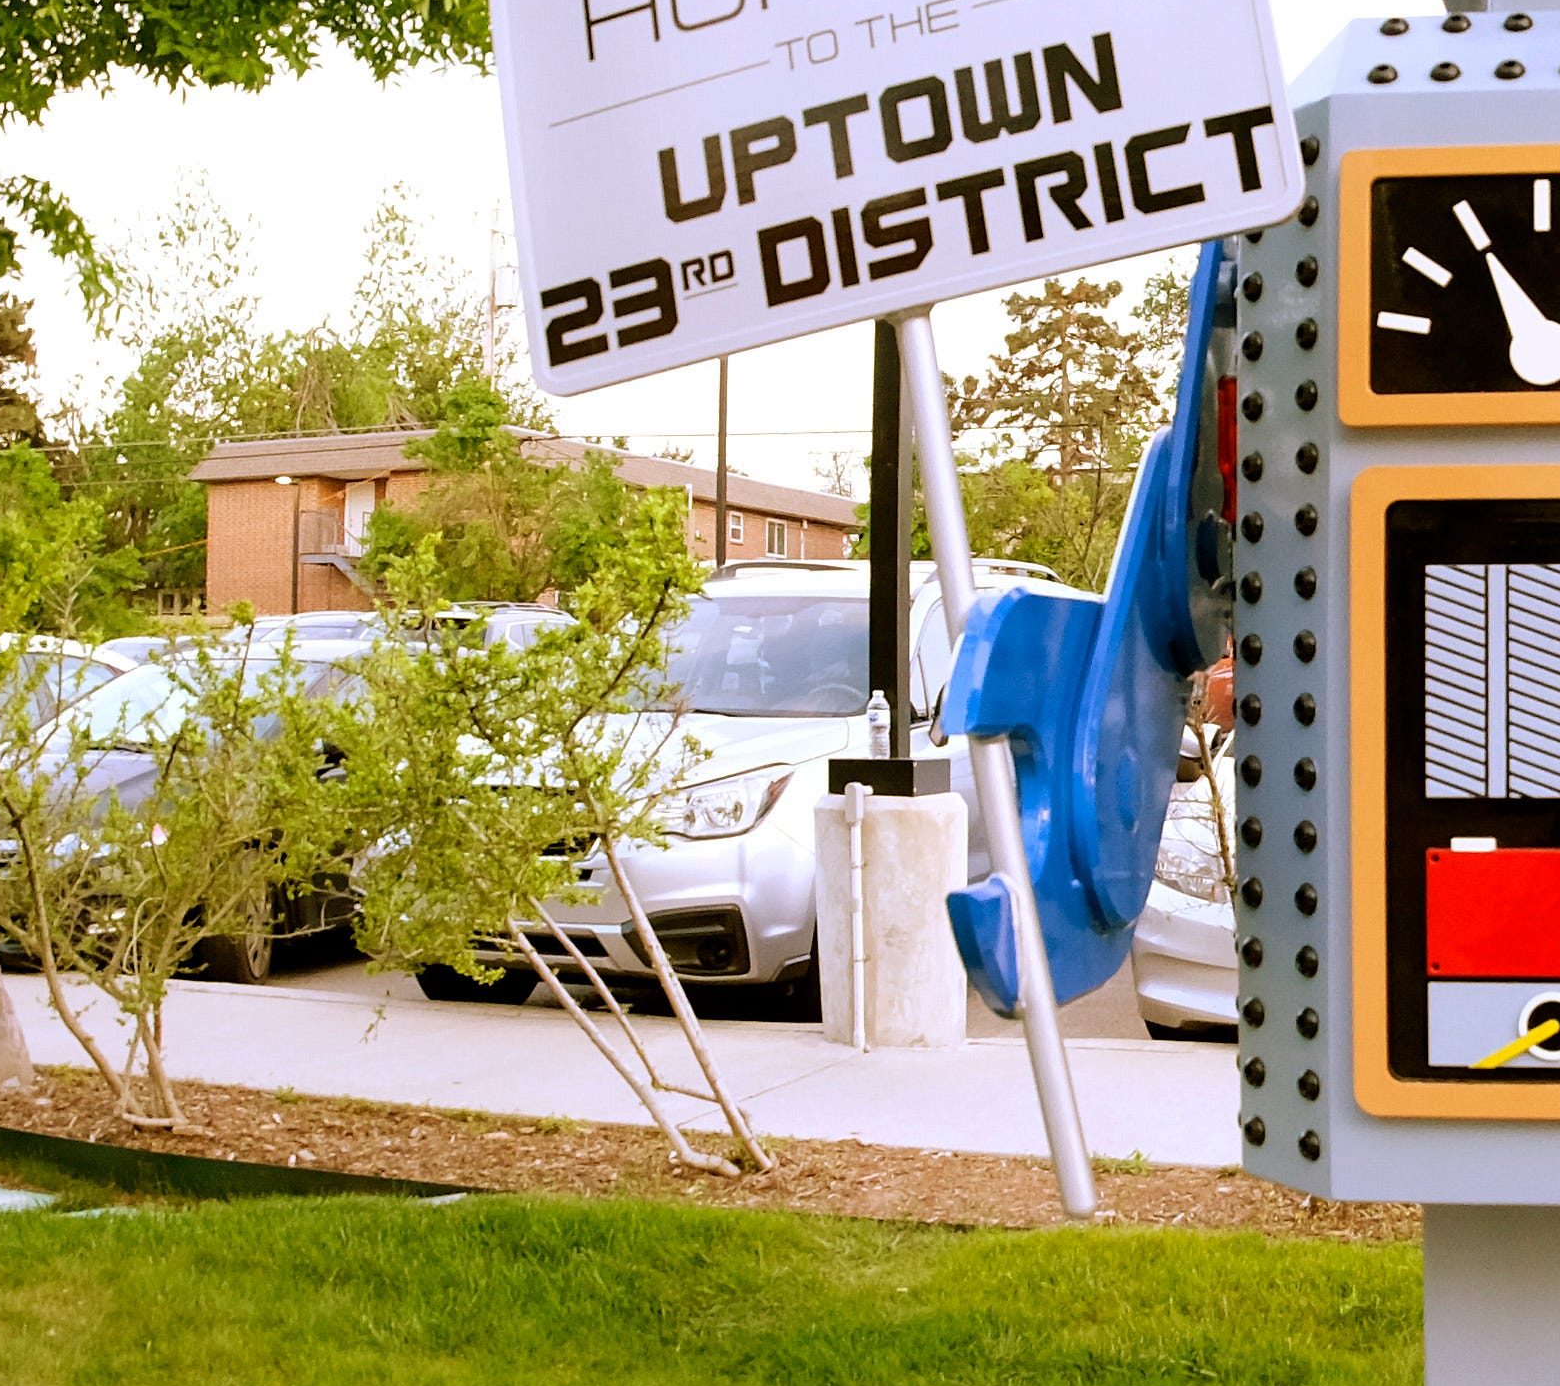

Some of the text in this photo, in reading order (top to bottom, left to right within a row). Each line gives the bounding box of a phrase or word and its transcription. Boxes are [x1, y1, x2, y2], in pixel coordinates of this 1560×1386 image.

[657, 31, 1124, 224] UPTOWN
[773, 29, 841, 73] TO
[756, 103, 1275, 309] DISTRICT
